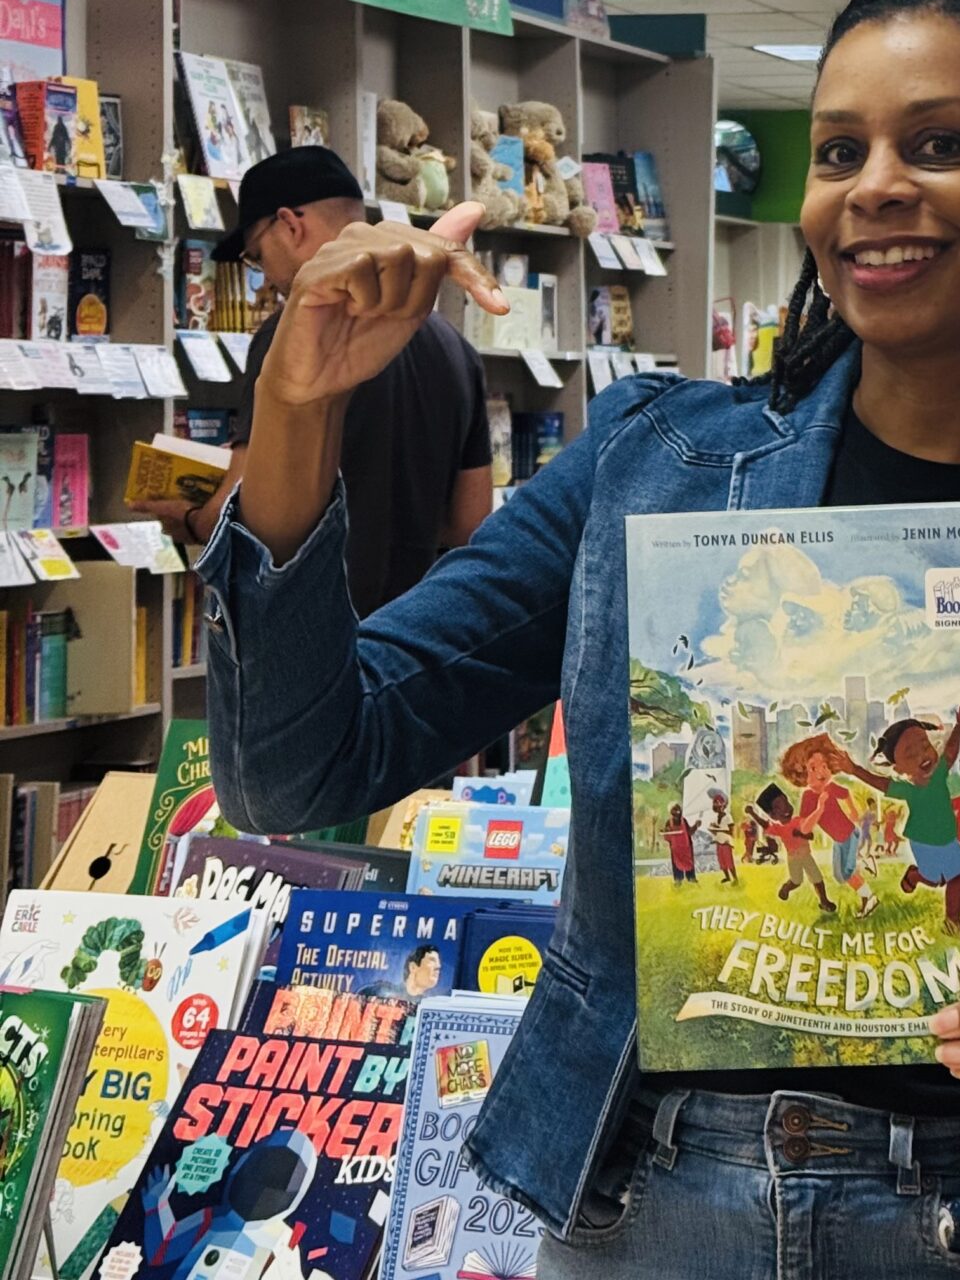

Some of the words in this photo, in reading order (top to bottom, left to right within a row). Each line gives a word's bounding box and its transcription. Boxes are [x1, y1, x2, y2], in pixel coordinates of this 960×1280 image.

[693, 533, 737, 549] TONYA
[741, 531, 796, 547] DUNCAN
[800, 530, 835, 545] ELLIS
[902, 526, 941, 541] JENIN
[177, 760, 212, 785] CHR
[487, 831, 520, 848] LEGO
[201, 856, 256, 902] DOG
[437, 864, 560, 892] MINECRAFT
[11, 921, 38, 933] CARLE
[14, 909, 41, 922] ERIC
[300, 910, 457, 941] SUPERMA
[692, 904, 759, 933] THEY
[759, 913, 832, 951] BUILT
[841, 931, 876, 956] ME
[884, 925, 936, 956] FOR
[296, 943, 321, 967] THE
[325, 944, 390, 971] OFFICIAL
[290, 967, 355, 992] ACTIVITY
[182, 1007, 212, 1029] 64
[711, 998, 728, 1012] THE
[730, 1001, 760, 1016] STORY
[761, 1009, 774, 1020] OF
[774, 1010, 831, 1031] JUNETEENTH
[833, 1021, 852, 1033] AND
[854, 1022, 905, 1034] HOUSTON'S
[0, 1013, 49, 1078] CTS
[102, 1022, 128, 1042] ery
[94, 1043, 165, 1063] terpillar's
[215, 1034, 365, 1095] PAINT
[353, 1054, 411, 1096] BY
[453, 1043, 476, 1062] NO
[446, 1057, 484, 1078] MORE
[101, 1069, 152, 1102] BIG
[172, 1082, 405, 1160] STICKER
[419, 1111, 479, 1142] BOO
[334, 1154, 398, 1185] KIDS
[415, 1148, 486, 1191] GIF
[464, 1195, 547, 1238] 202
